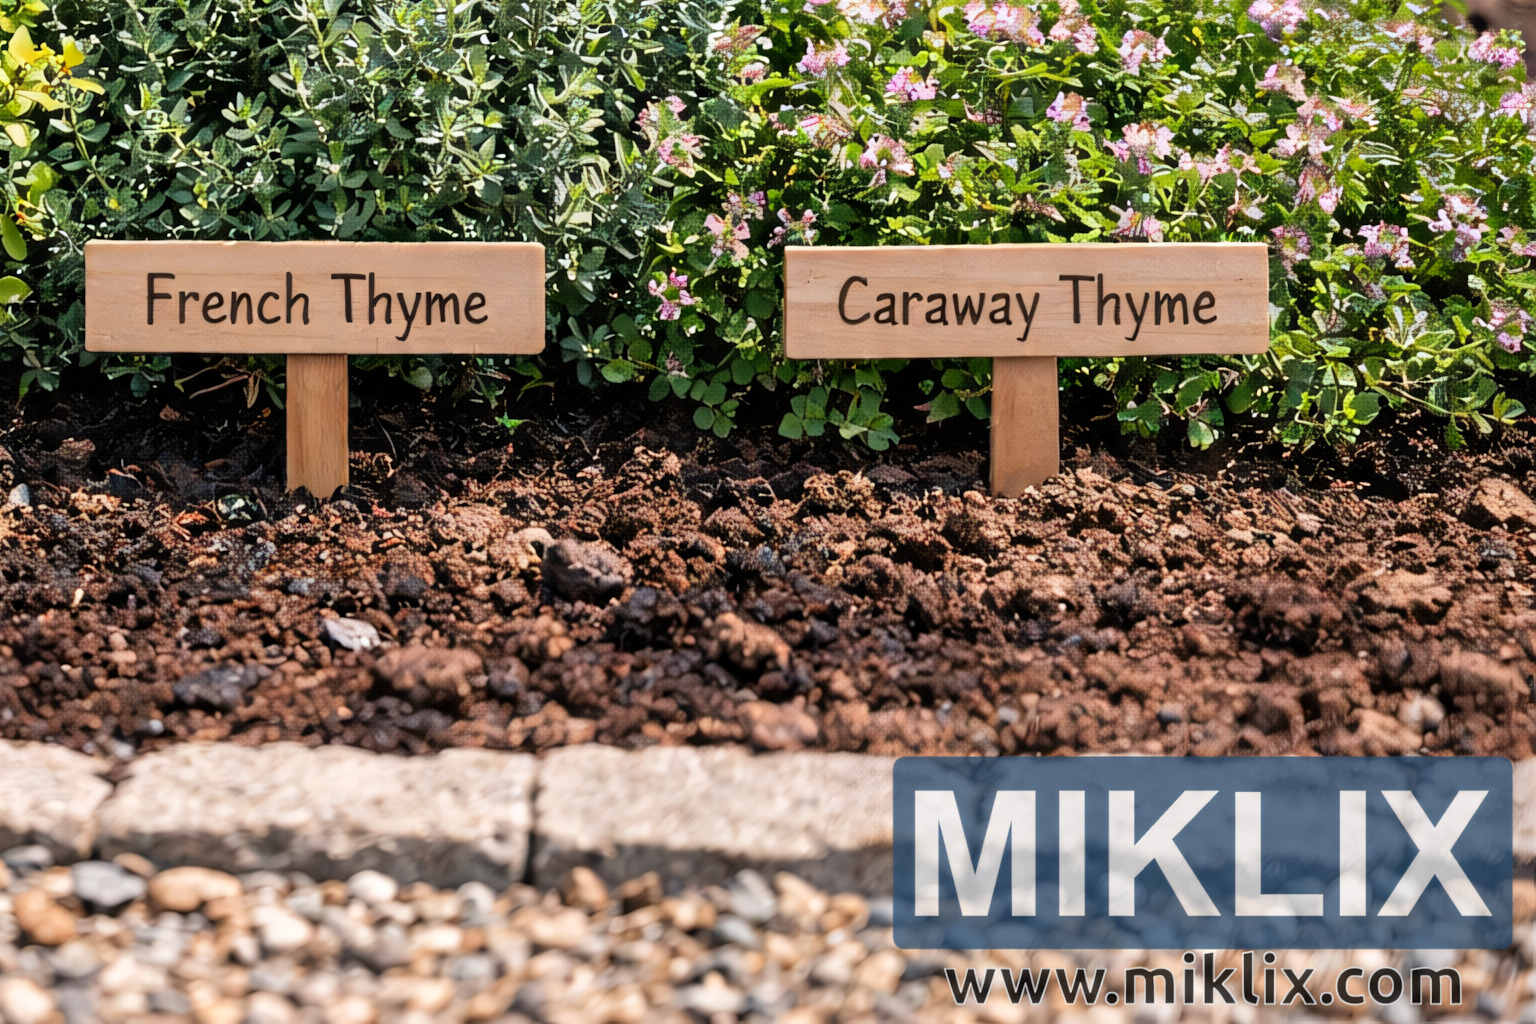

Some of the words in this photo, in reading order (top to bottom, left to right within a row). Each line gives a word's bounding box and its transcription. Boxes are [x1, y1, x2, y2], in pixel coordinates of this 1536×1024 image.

[145, 270, 311, 326] French
[329, 270, 490, 343] Thyme
[836, 274, 1041, 344] Caraway
[1057, 272, 1219, 343] Thyme
